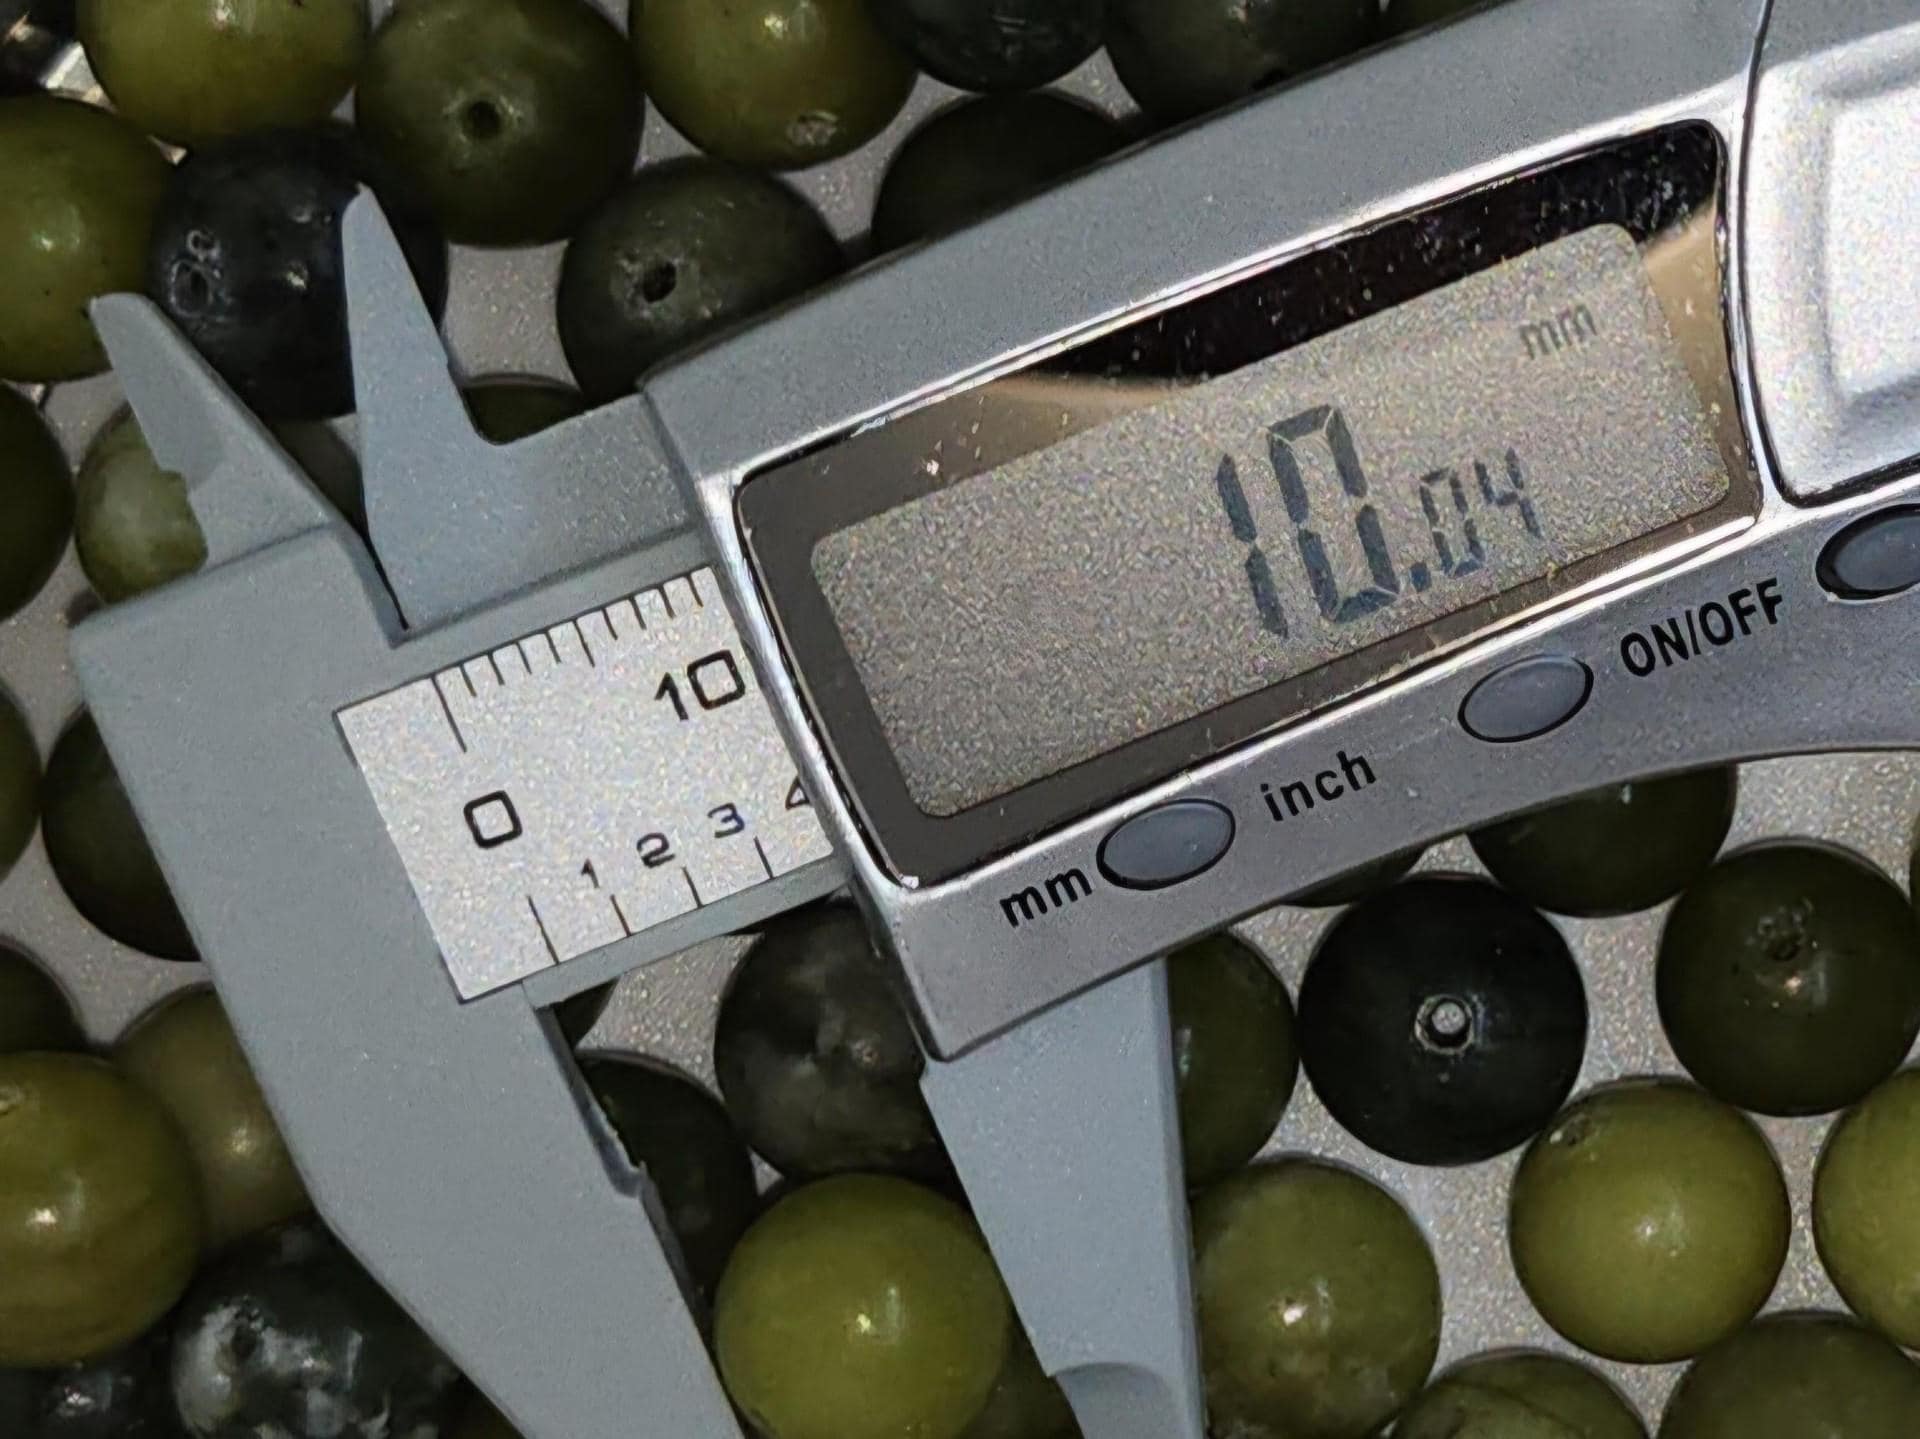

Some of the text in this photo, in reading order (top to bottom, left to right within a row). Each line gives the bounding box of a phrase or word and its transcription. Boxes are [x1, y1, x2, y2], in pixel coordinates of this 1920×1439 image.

[1520, 304, 1597, 360] mm
[1217, 404, 1542, 638] 10.04
[1620, 578, 1783, 678] ON/OFF
[654, 649, 746, 721] 10
[463, 790, 523, 850] 0
[1260, 749, 1376, 823] inch
[580, 859, 599, 889] 1
[635, 832, 675, 868] 2
[707, 802, 745, 839] 3
[1000, 866, 1092, 928] mm
